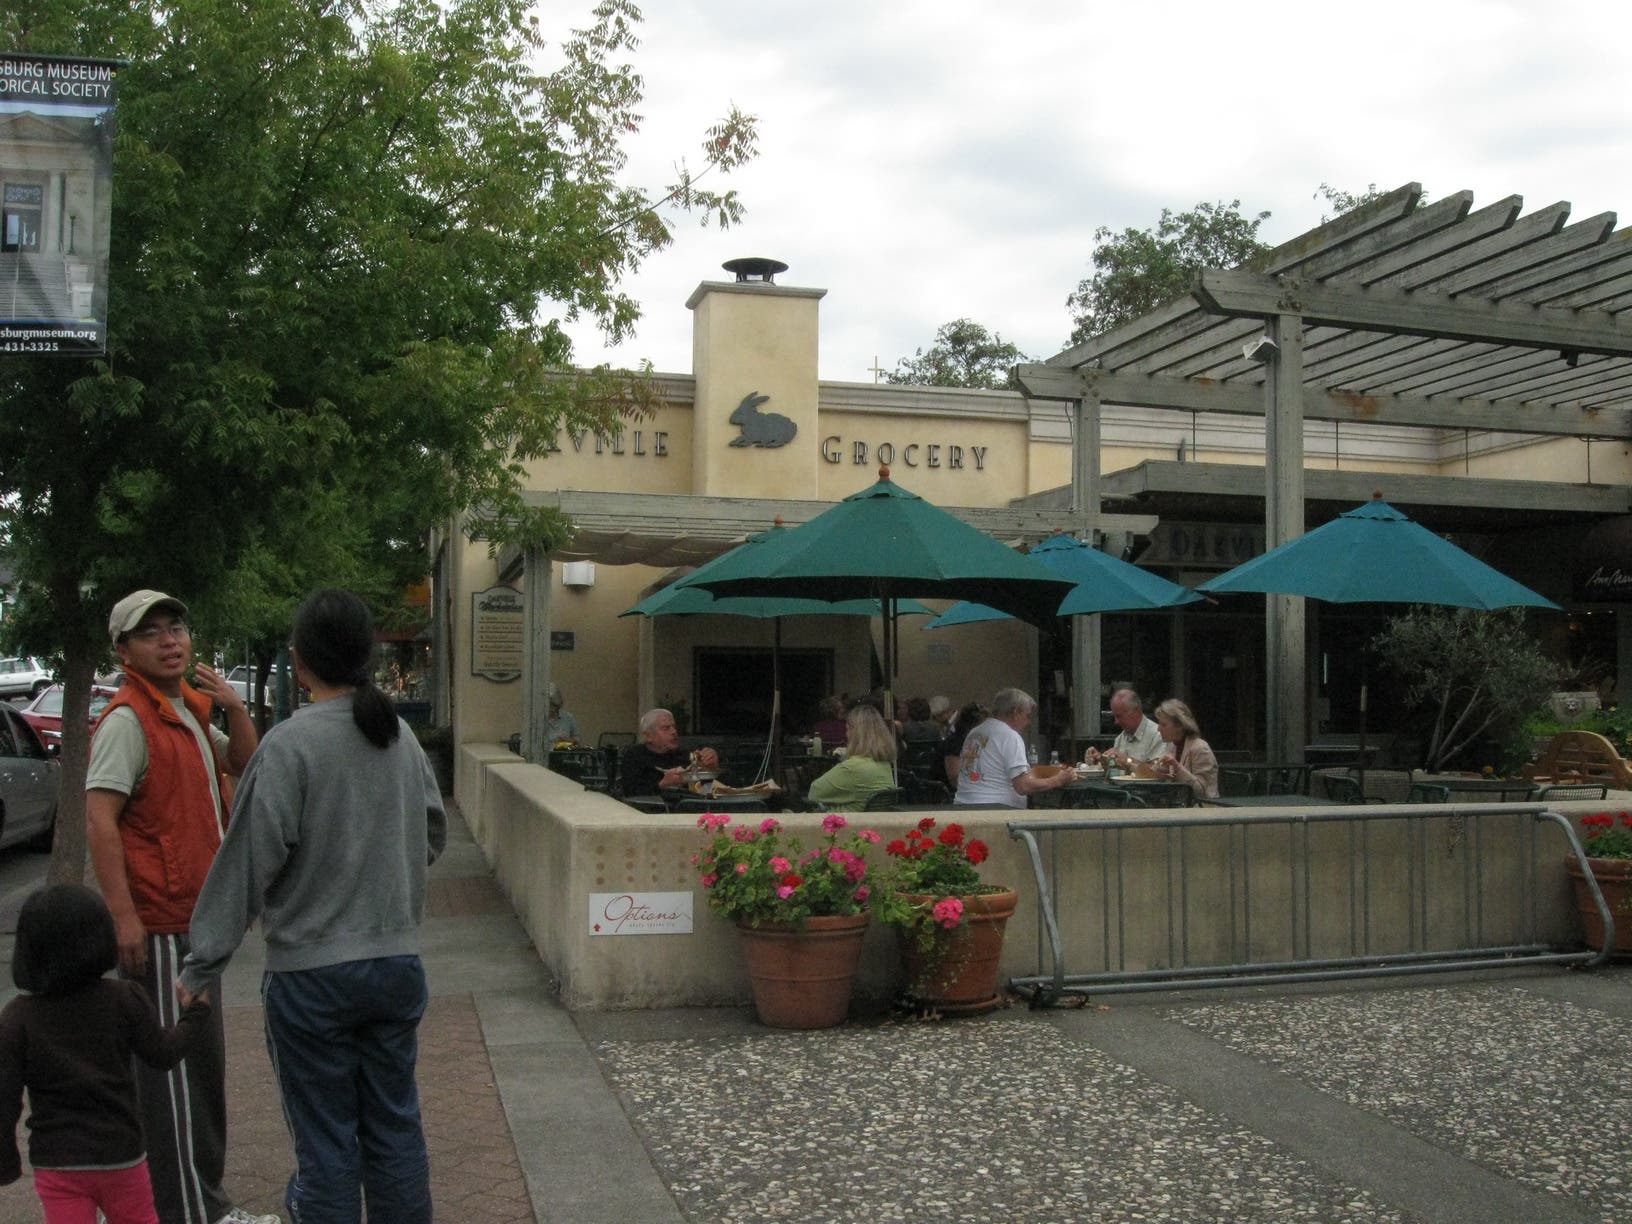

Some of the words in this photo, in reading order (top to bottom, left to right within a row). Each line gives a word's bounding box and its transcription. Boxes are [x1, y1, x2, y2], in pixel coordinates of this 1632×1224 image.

[47, 63, 111, 81] MUSEUM
[0, 79, 48, 95] ORICAL
[52, 81, 110, 98] SOCIETY
[0, 328, 97, 341] sburgmuseum.org
[823, 435, 988, 470] GROCERY
[604, 895, 682, 933] Options
